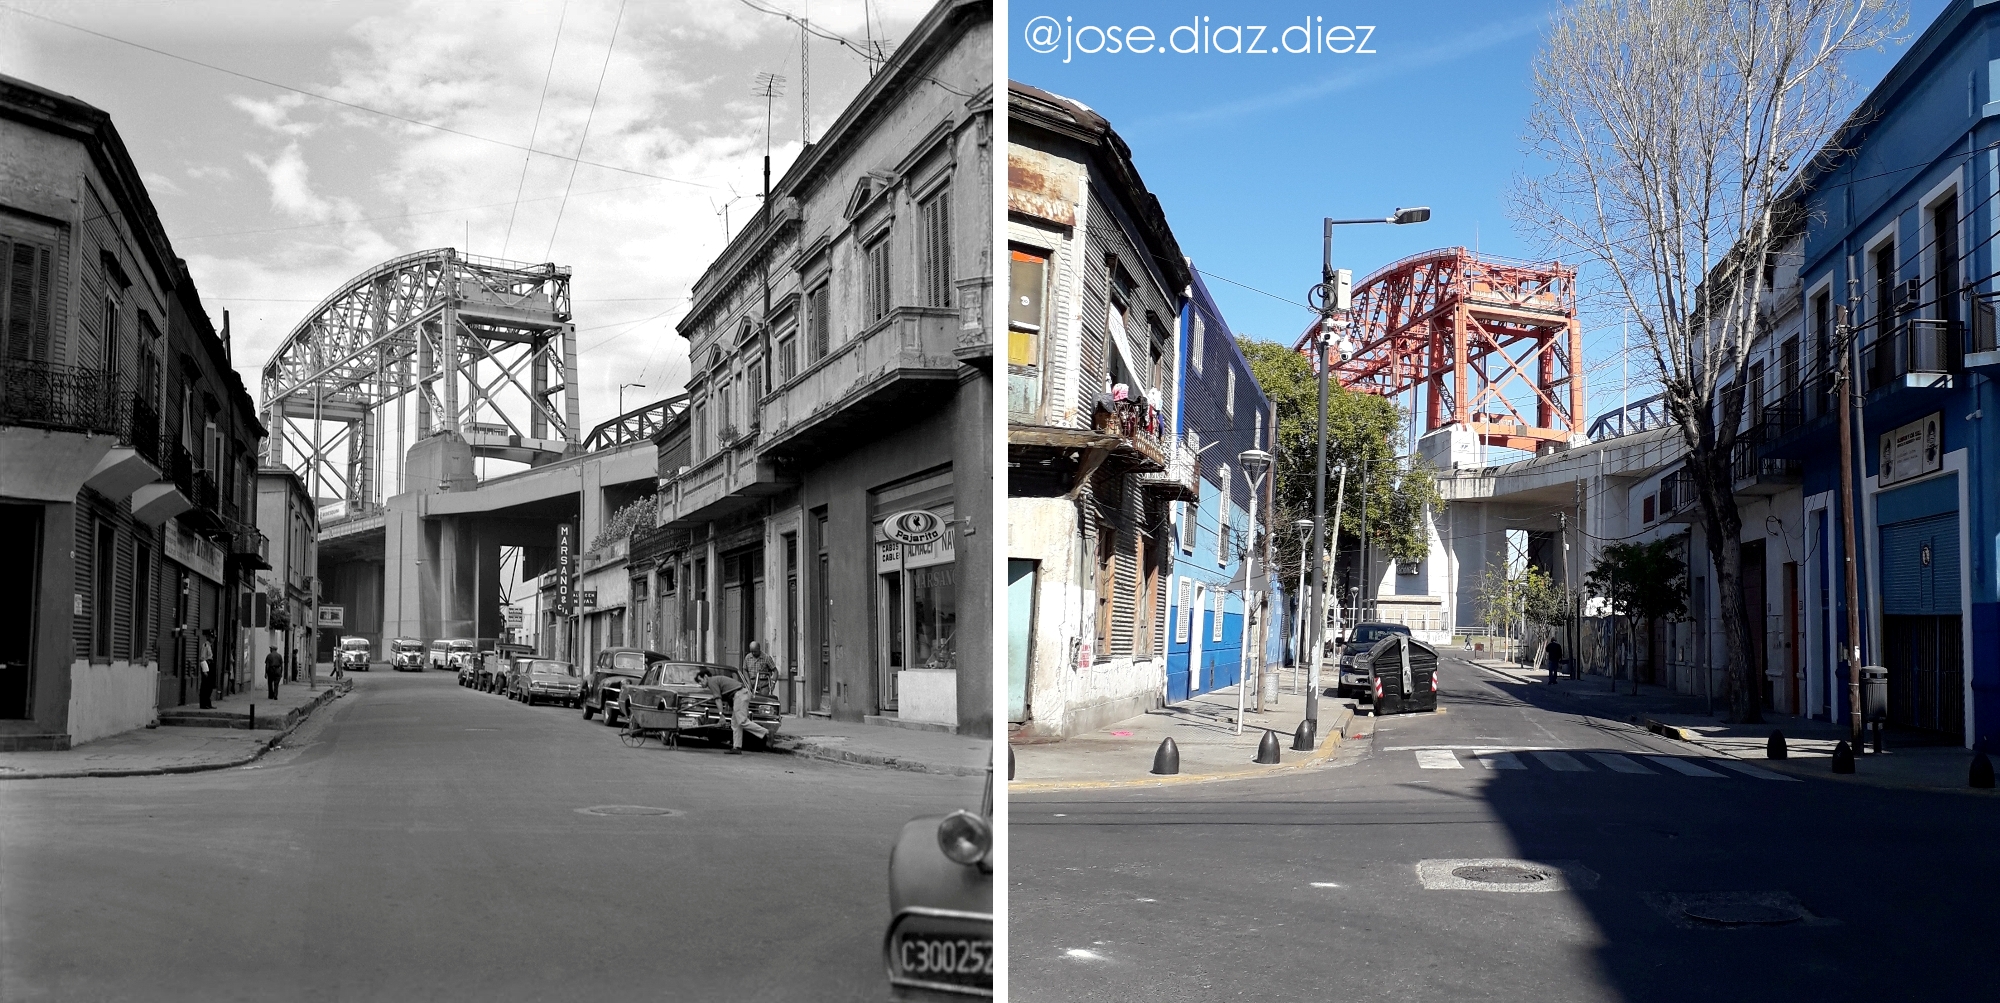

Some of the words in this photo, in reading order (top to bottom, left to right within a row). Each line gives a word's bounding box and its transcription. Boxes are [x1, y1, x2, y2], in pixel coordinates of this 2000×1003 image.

[895, 530, 938, 542] Pajarito
[560, 527, 568, 595] MARSANO
[561, 596, 567, 604] &
